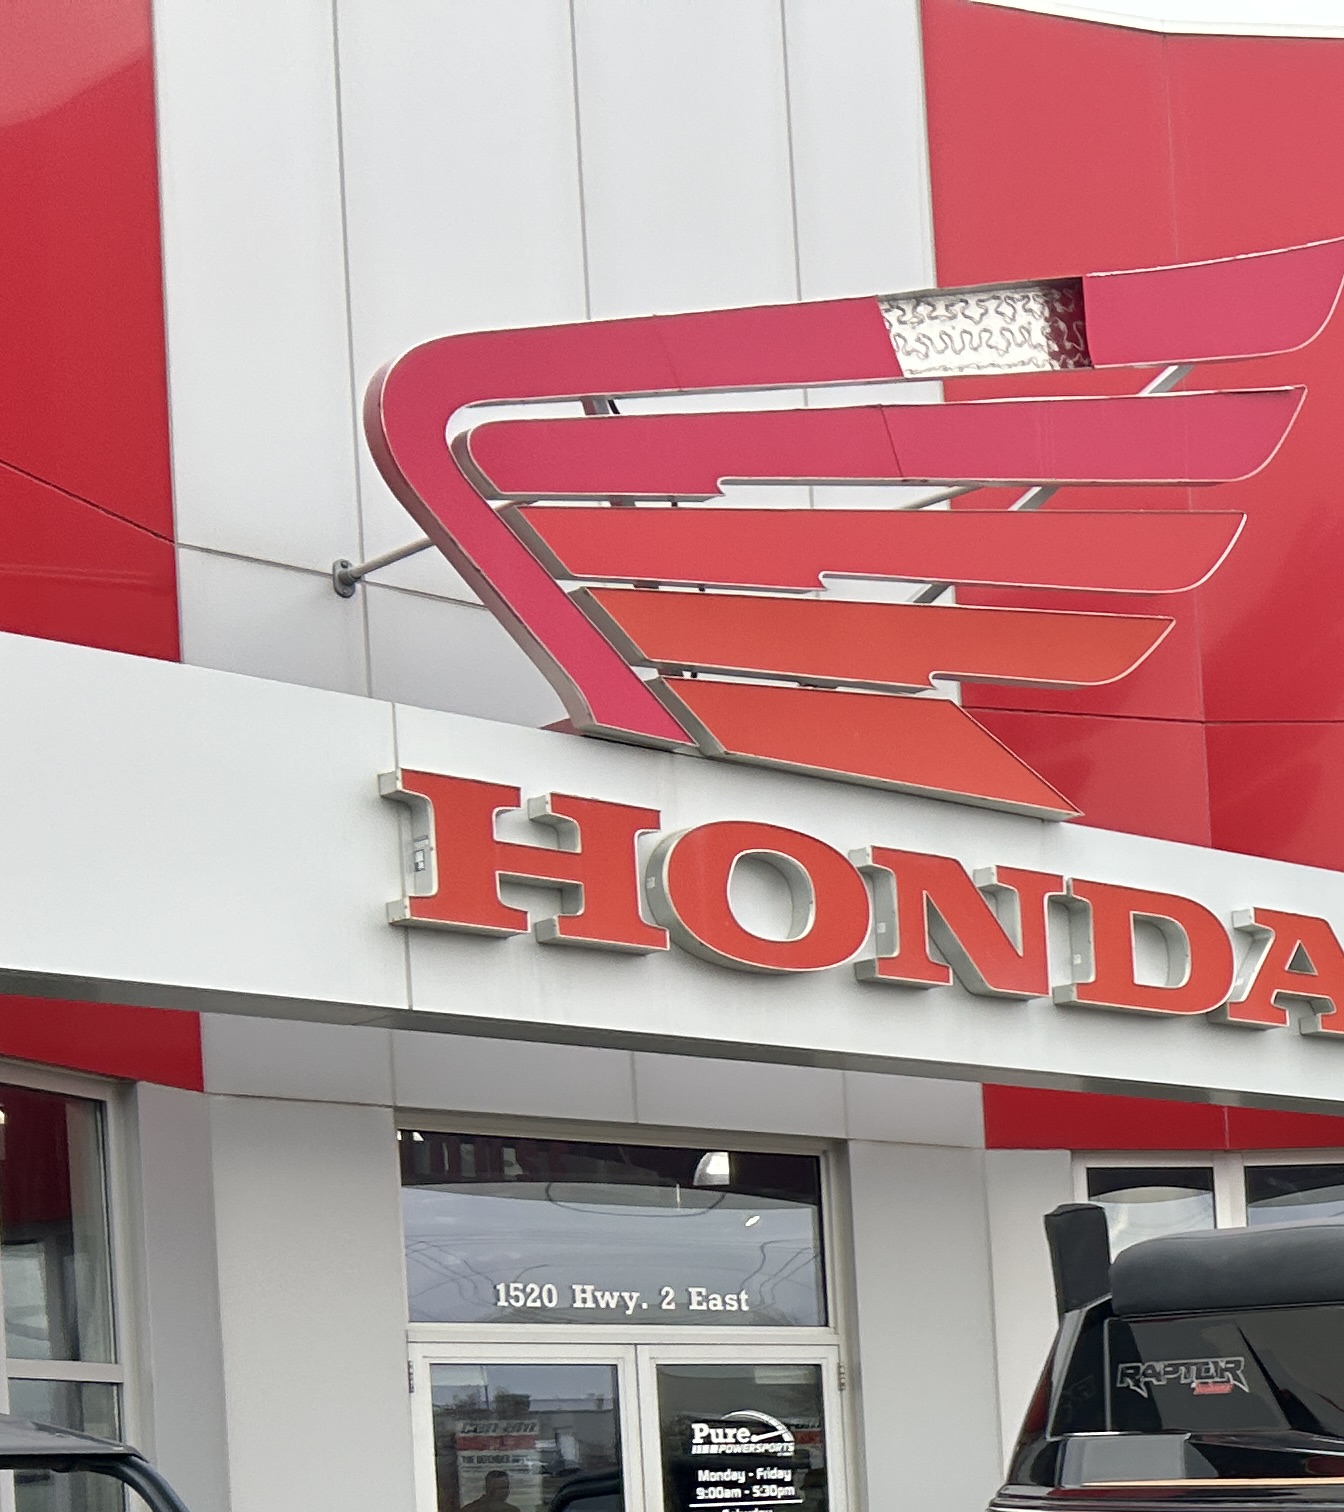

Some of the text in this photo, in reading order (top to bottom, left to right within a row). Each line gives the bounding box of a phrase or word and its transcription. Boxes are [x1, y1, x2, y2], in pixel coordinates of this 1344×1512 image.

[495, 1282, 749, 1315] 1520 Hwy. 2 East
[1116, 1357, 1250, 1398] RAPTOR
[691, 1423, 751, 1444] Pure
[719, 1442, 796, 1454] POWERSPORTS
[698, 1468, 746, 1484] Monday
[756, 1466, 792, 1481] Friday
[696, 1486, 742, 1500] 9:00am
[752, 1484, 796, 1498] 5:30pm
